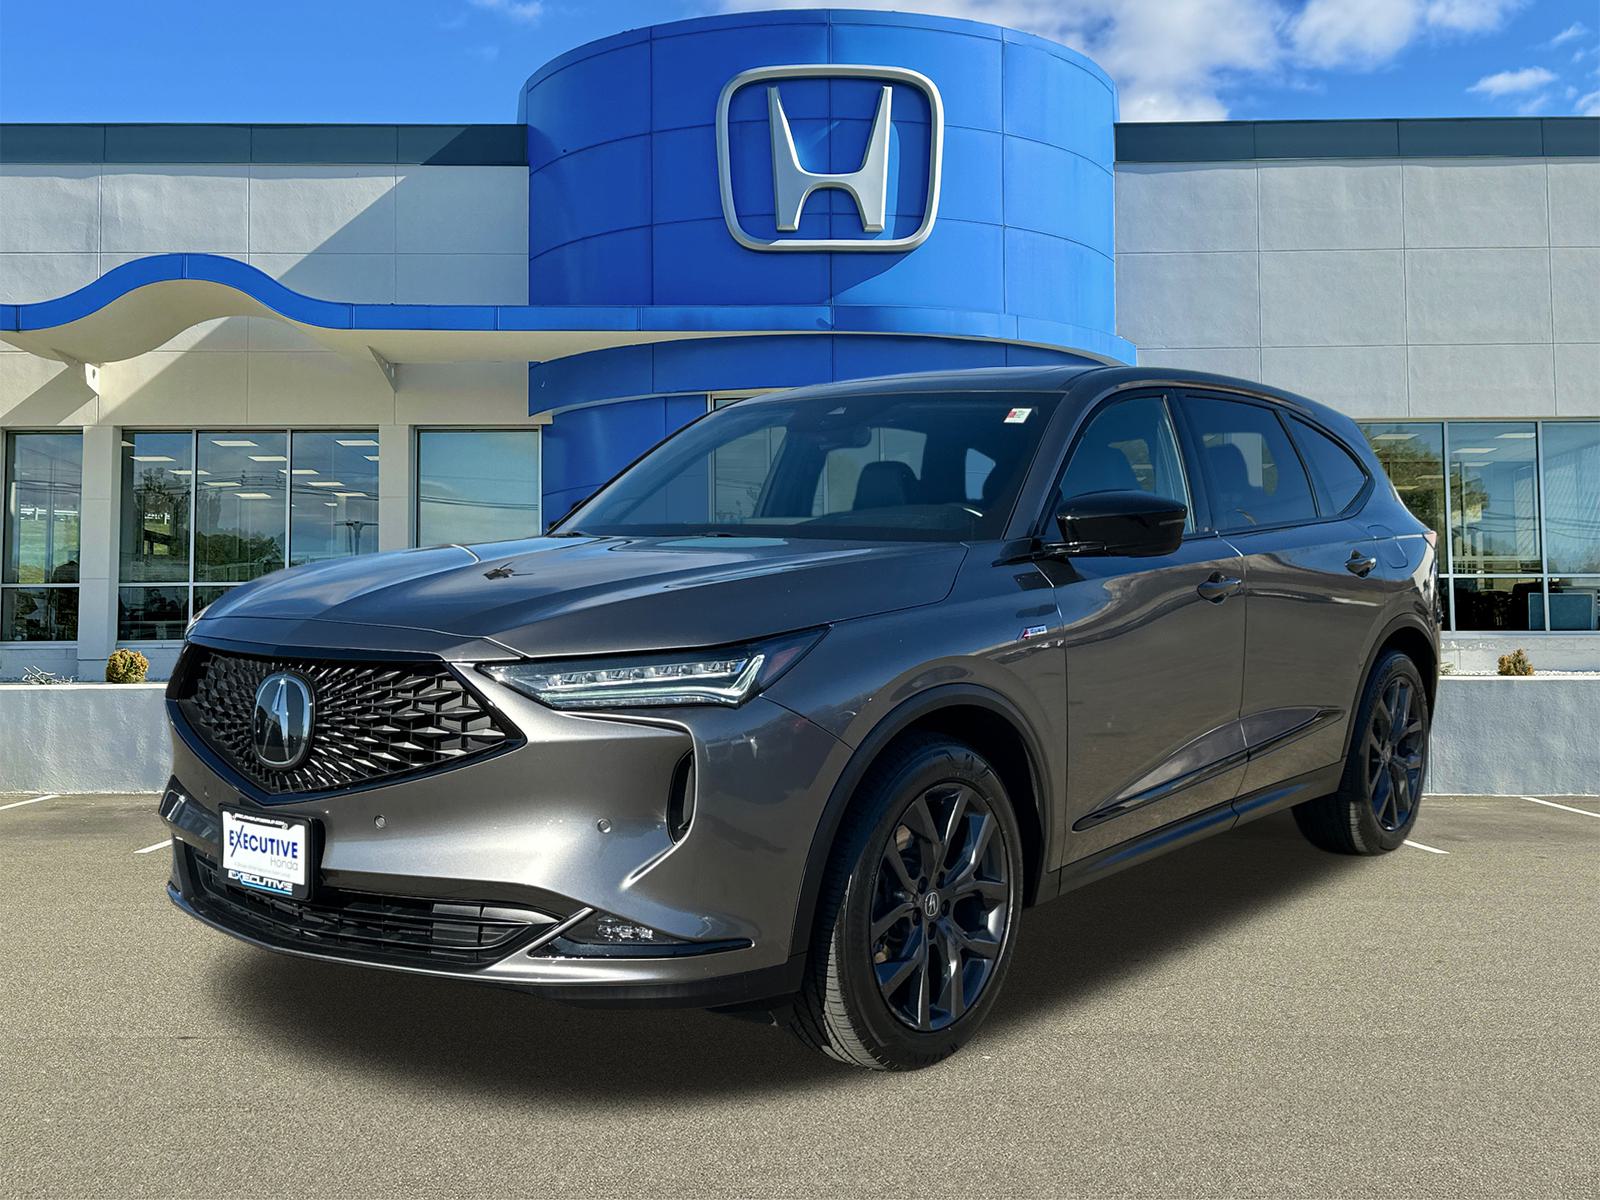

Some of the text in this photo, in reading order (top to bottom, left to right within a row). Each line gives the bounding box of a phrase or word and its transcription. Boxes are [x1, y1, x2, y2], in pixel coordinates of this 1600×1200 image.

[229, 825, 298, 859] EXECUTIVE
[270, 856, 298, 871] Honda
[228, 869, 293, 891] EXECUTIVE
